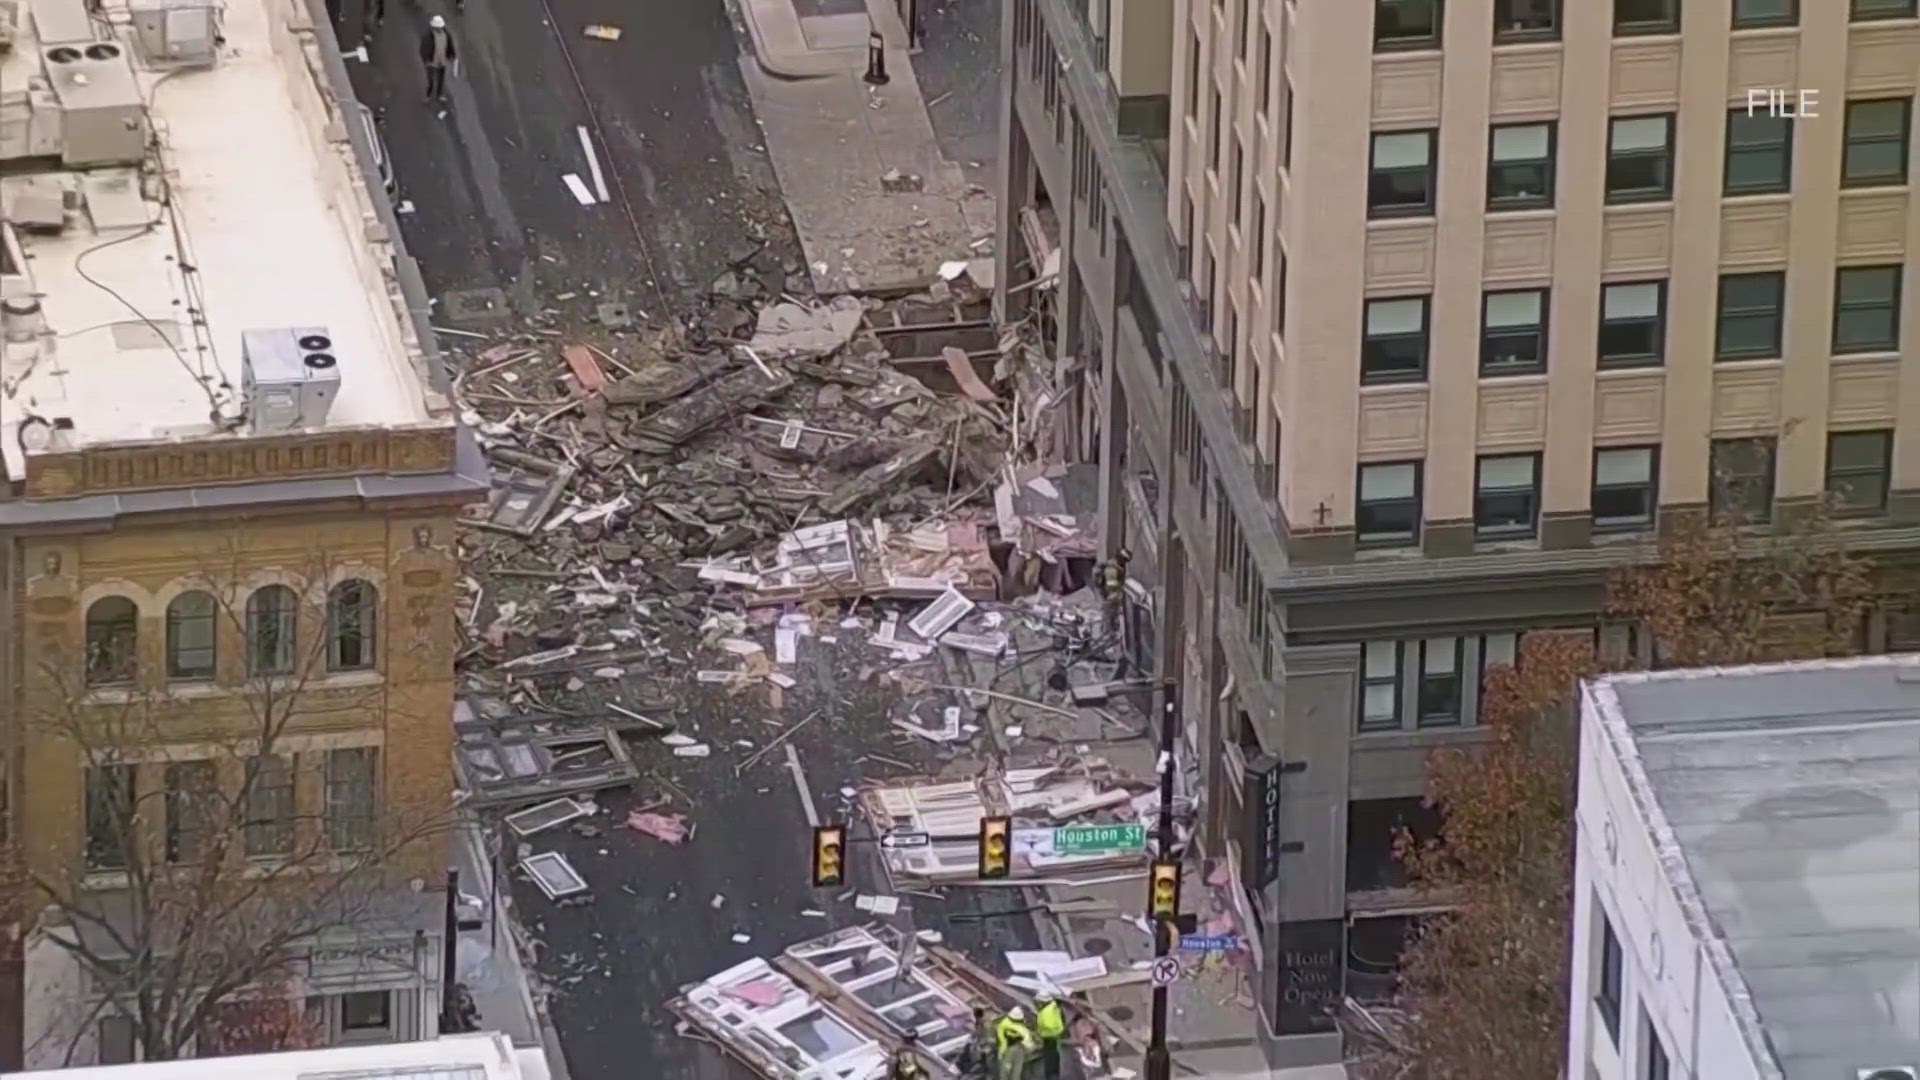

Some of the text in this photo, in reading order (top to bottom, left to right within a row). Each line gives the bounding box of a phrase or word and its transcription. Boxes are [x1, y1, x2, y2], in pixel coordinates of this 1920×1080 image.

[1265, 768, 1278, 859] HOTEL
[1056, 826, 1141, 844] Houston St
[1285, 950, 1334, 967] Hotel
[1289, 969, 1328, 983] Now
[1284, 988, 1333, 1006] Open
